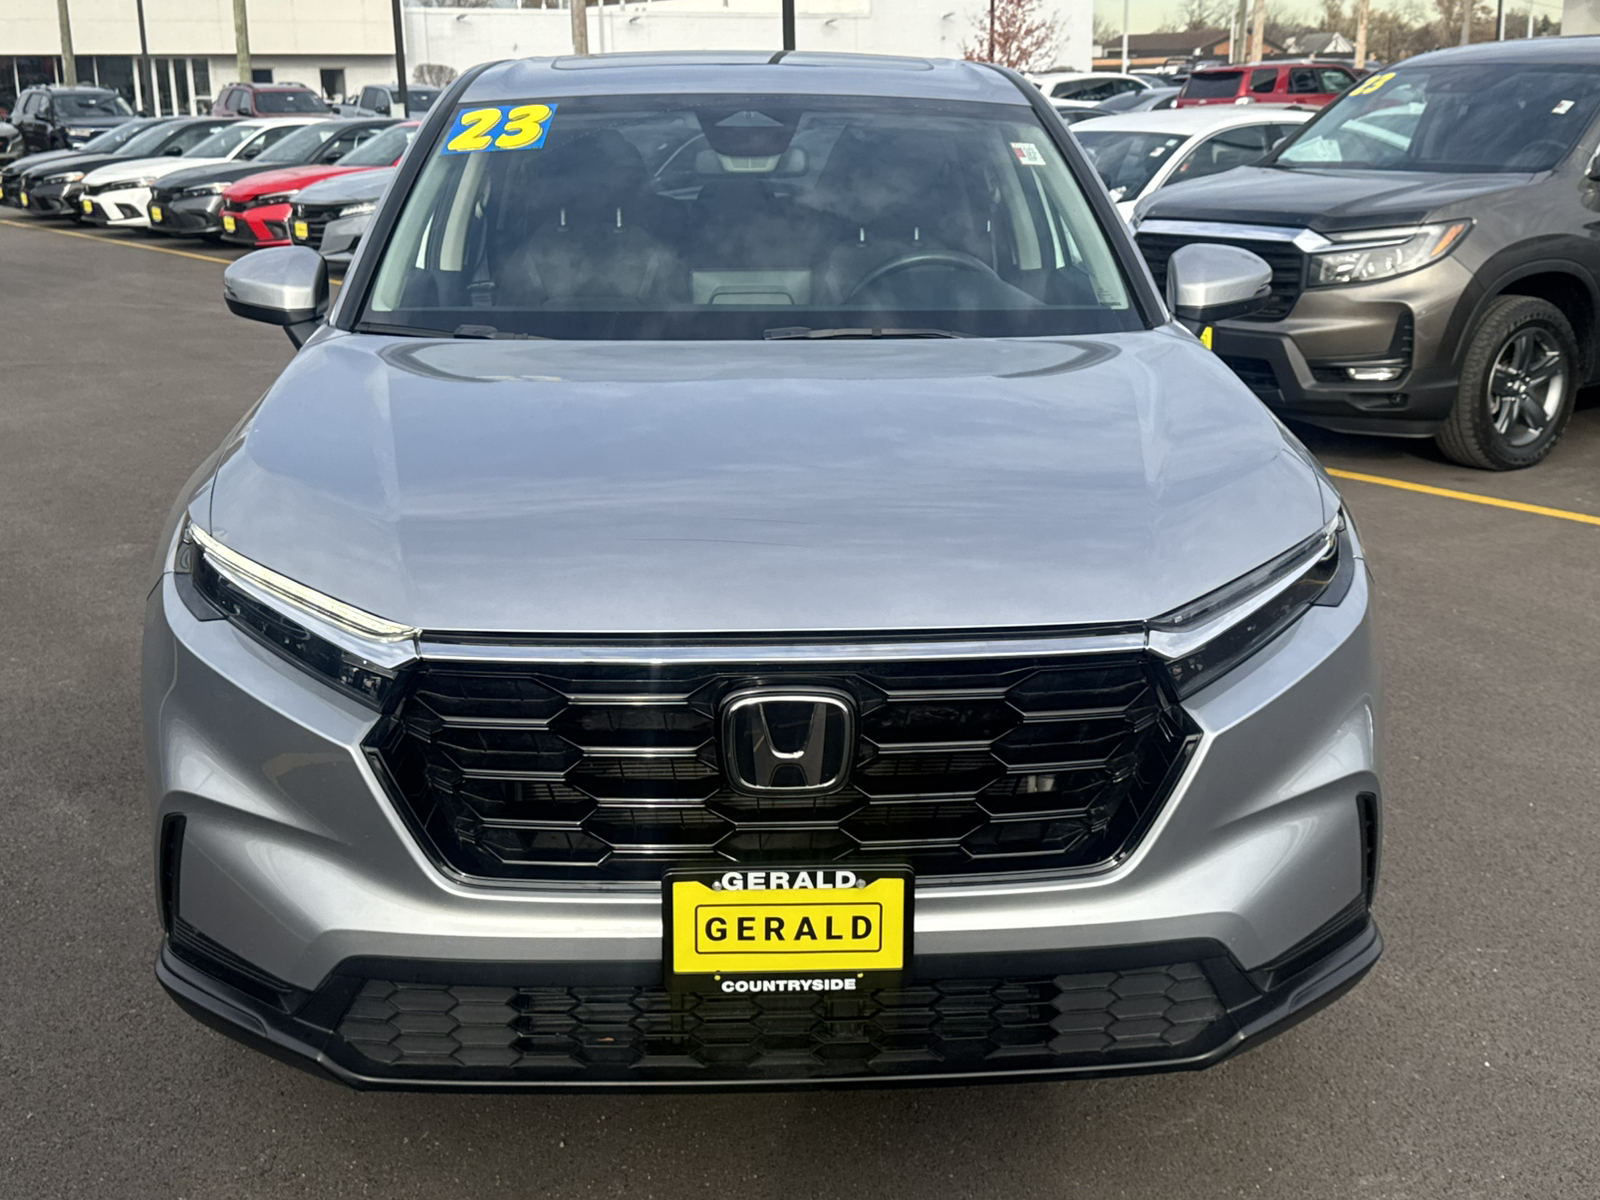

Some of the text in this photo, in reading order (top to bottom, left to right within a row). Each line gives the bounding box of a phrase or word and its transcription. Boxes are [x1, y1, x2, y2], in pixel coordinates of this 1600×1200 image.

[447, 104, 552, 151] 23
[721, 870, 857, 891] GERALD
[705, 915, 872, 941] GERALD
[721, 978, 856, 992] COUNTRYSIDE
